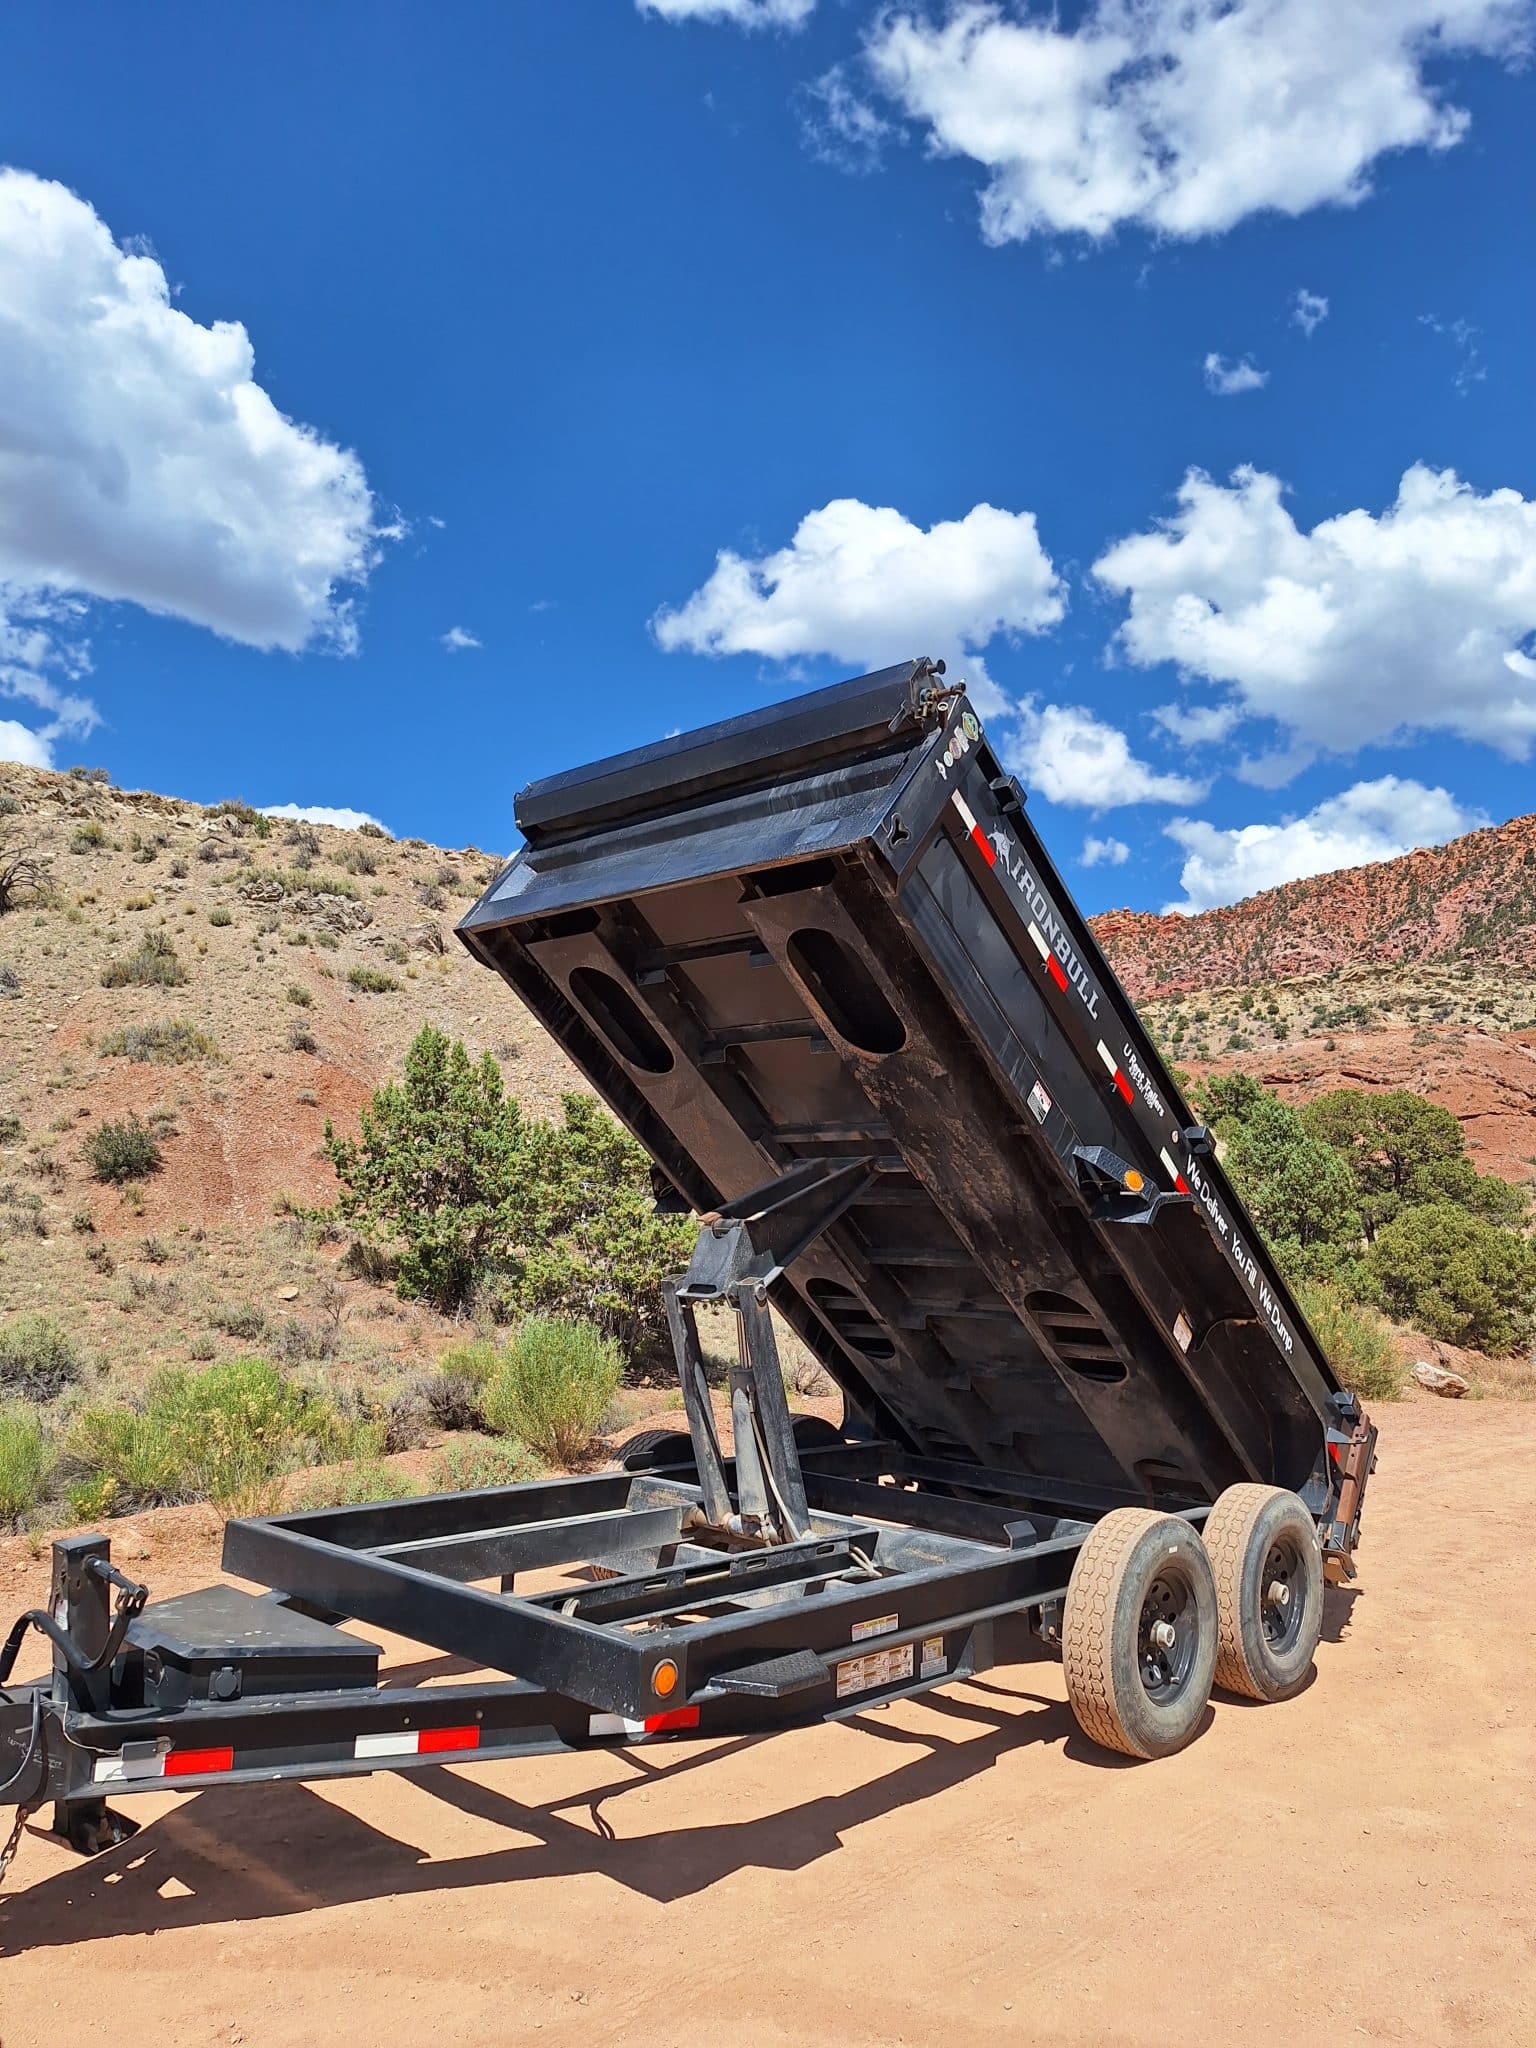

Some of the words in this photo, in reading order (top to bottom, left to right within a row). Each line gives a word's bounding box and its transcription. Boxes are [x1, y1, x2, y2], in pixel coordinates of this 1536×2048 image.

[1011, 857, 1099, 1020] IRONBULL
[1124, 1043, 1132, 1057] U
[1186, 1154, 1200, 1190] We
[1200, 1181, 1228, 1240] Deliver.
[1231, 1232, 1245, 1268] You
[1259, 1280, 1272, 1314] We
[1270, 1306, 1293, 1354] Dump.
